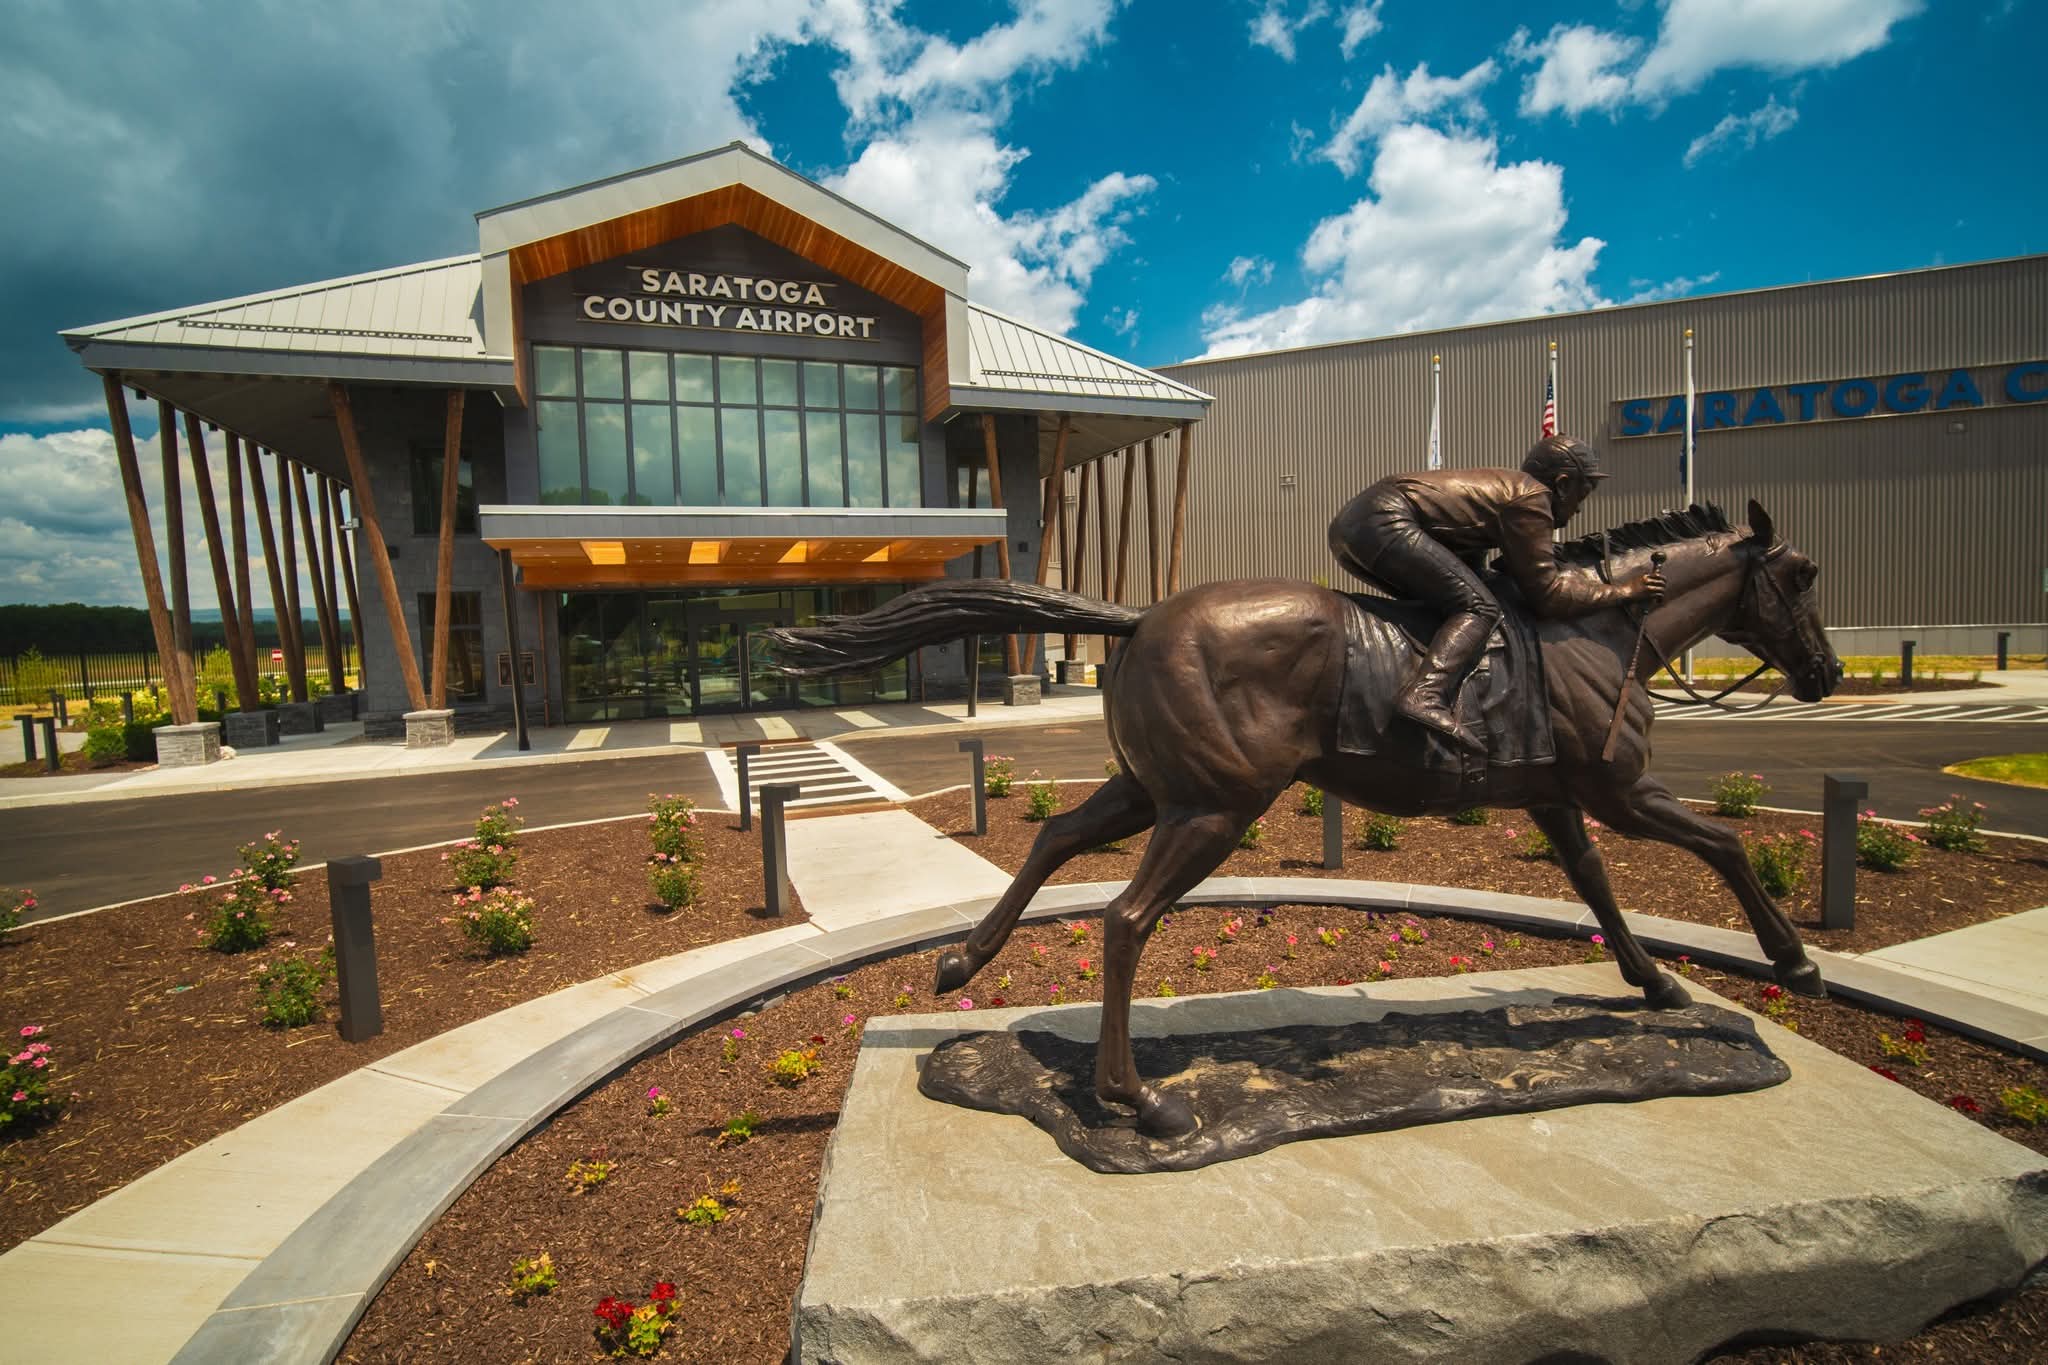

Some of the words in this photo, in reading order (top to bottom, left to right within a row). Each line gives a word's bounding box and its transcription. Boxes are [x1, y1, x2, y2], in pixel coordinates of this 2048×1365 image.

[642, 269, 826, 306] SARATOGA
[583, 295, 728, 327] COUNTY
[735, 307, 875, 338] AIRPORT
[1622, 370, 1984, 436] SARATOGA
